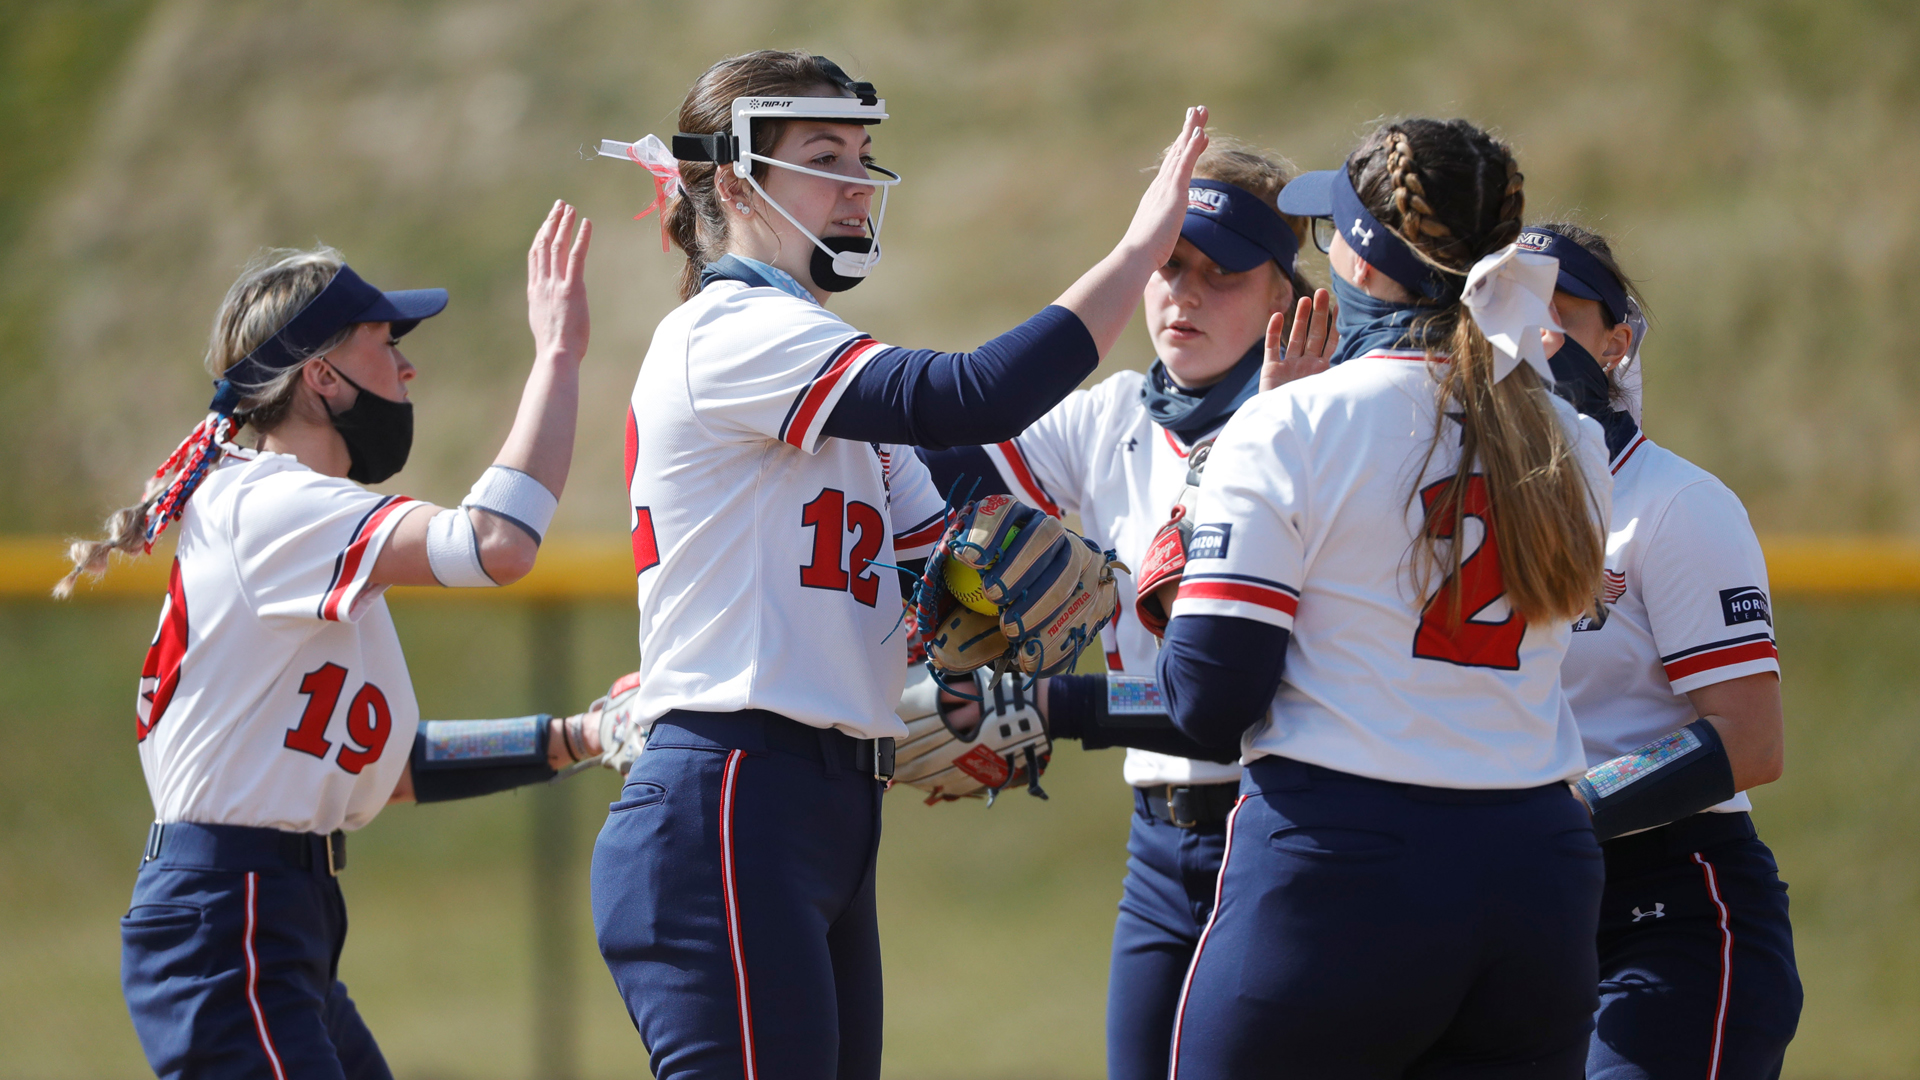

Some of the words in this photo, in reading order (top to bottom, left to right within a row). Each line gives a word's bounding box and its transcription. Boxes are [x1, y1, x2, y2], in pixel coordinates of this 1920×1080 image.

[1516, 233, 1552, 249] MU
[800, 487, 885, 609] 12
[1412, 472, 1527, 671] 2
[284, 661, 392, 775] 19
